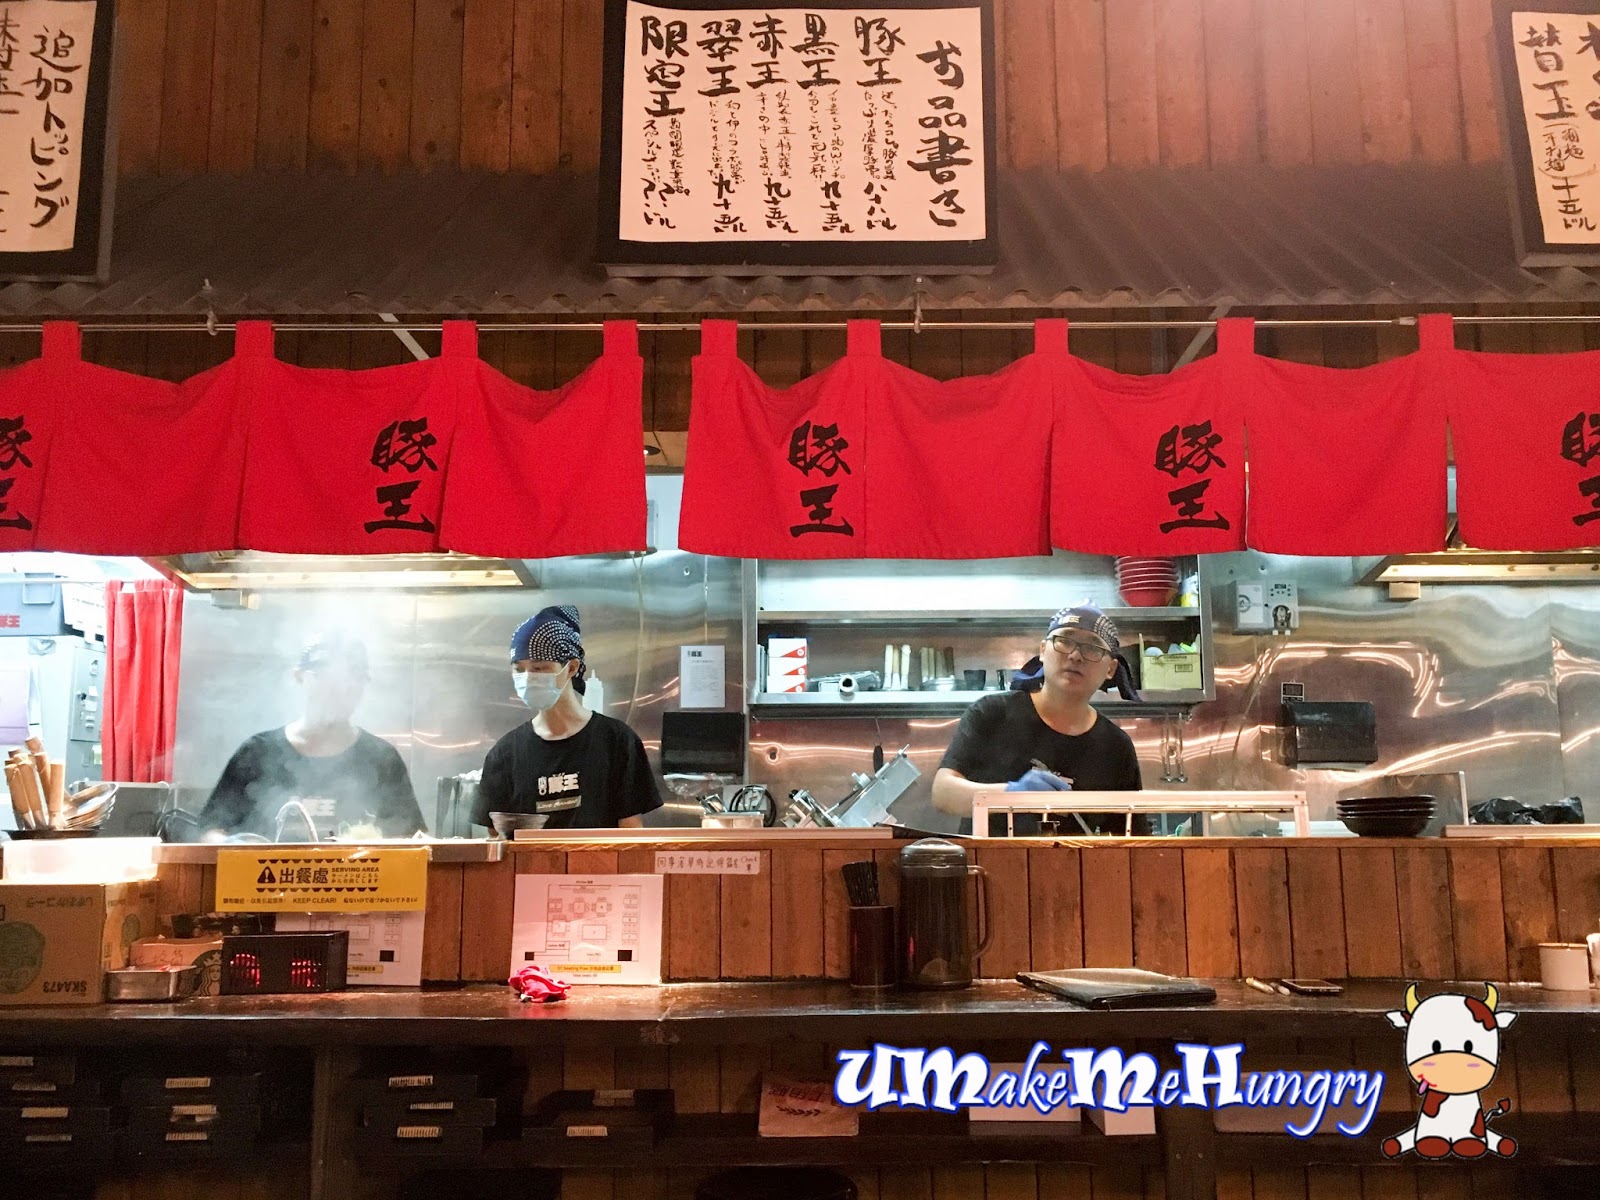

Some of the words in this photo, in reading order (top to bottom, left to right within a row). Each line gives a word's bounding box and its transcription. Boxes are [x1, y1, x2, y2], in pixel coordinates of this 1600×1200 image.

[746, 13, 791, 89] 赤王
[854, 16, 906, 88] 豚王
[1519, 22, 1579, 121] 替玉
[1552, 176, 1597, 232] 十五ドル
[364, 417, 439, 535] 豚王
[787, 420, 855, 538] 豚王
[1154, 419, 1230, 535] 豚王
[279, 867, 329, 885] 出餐處
